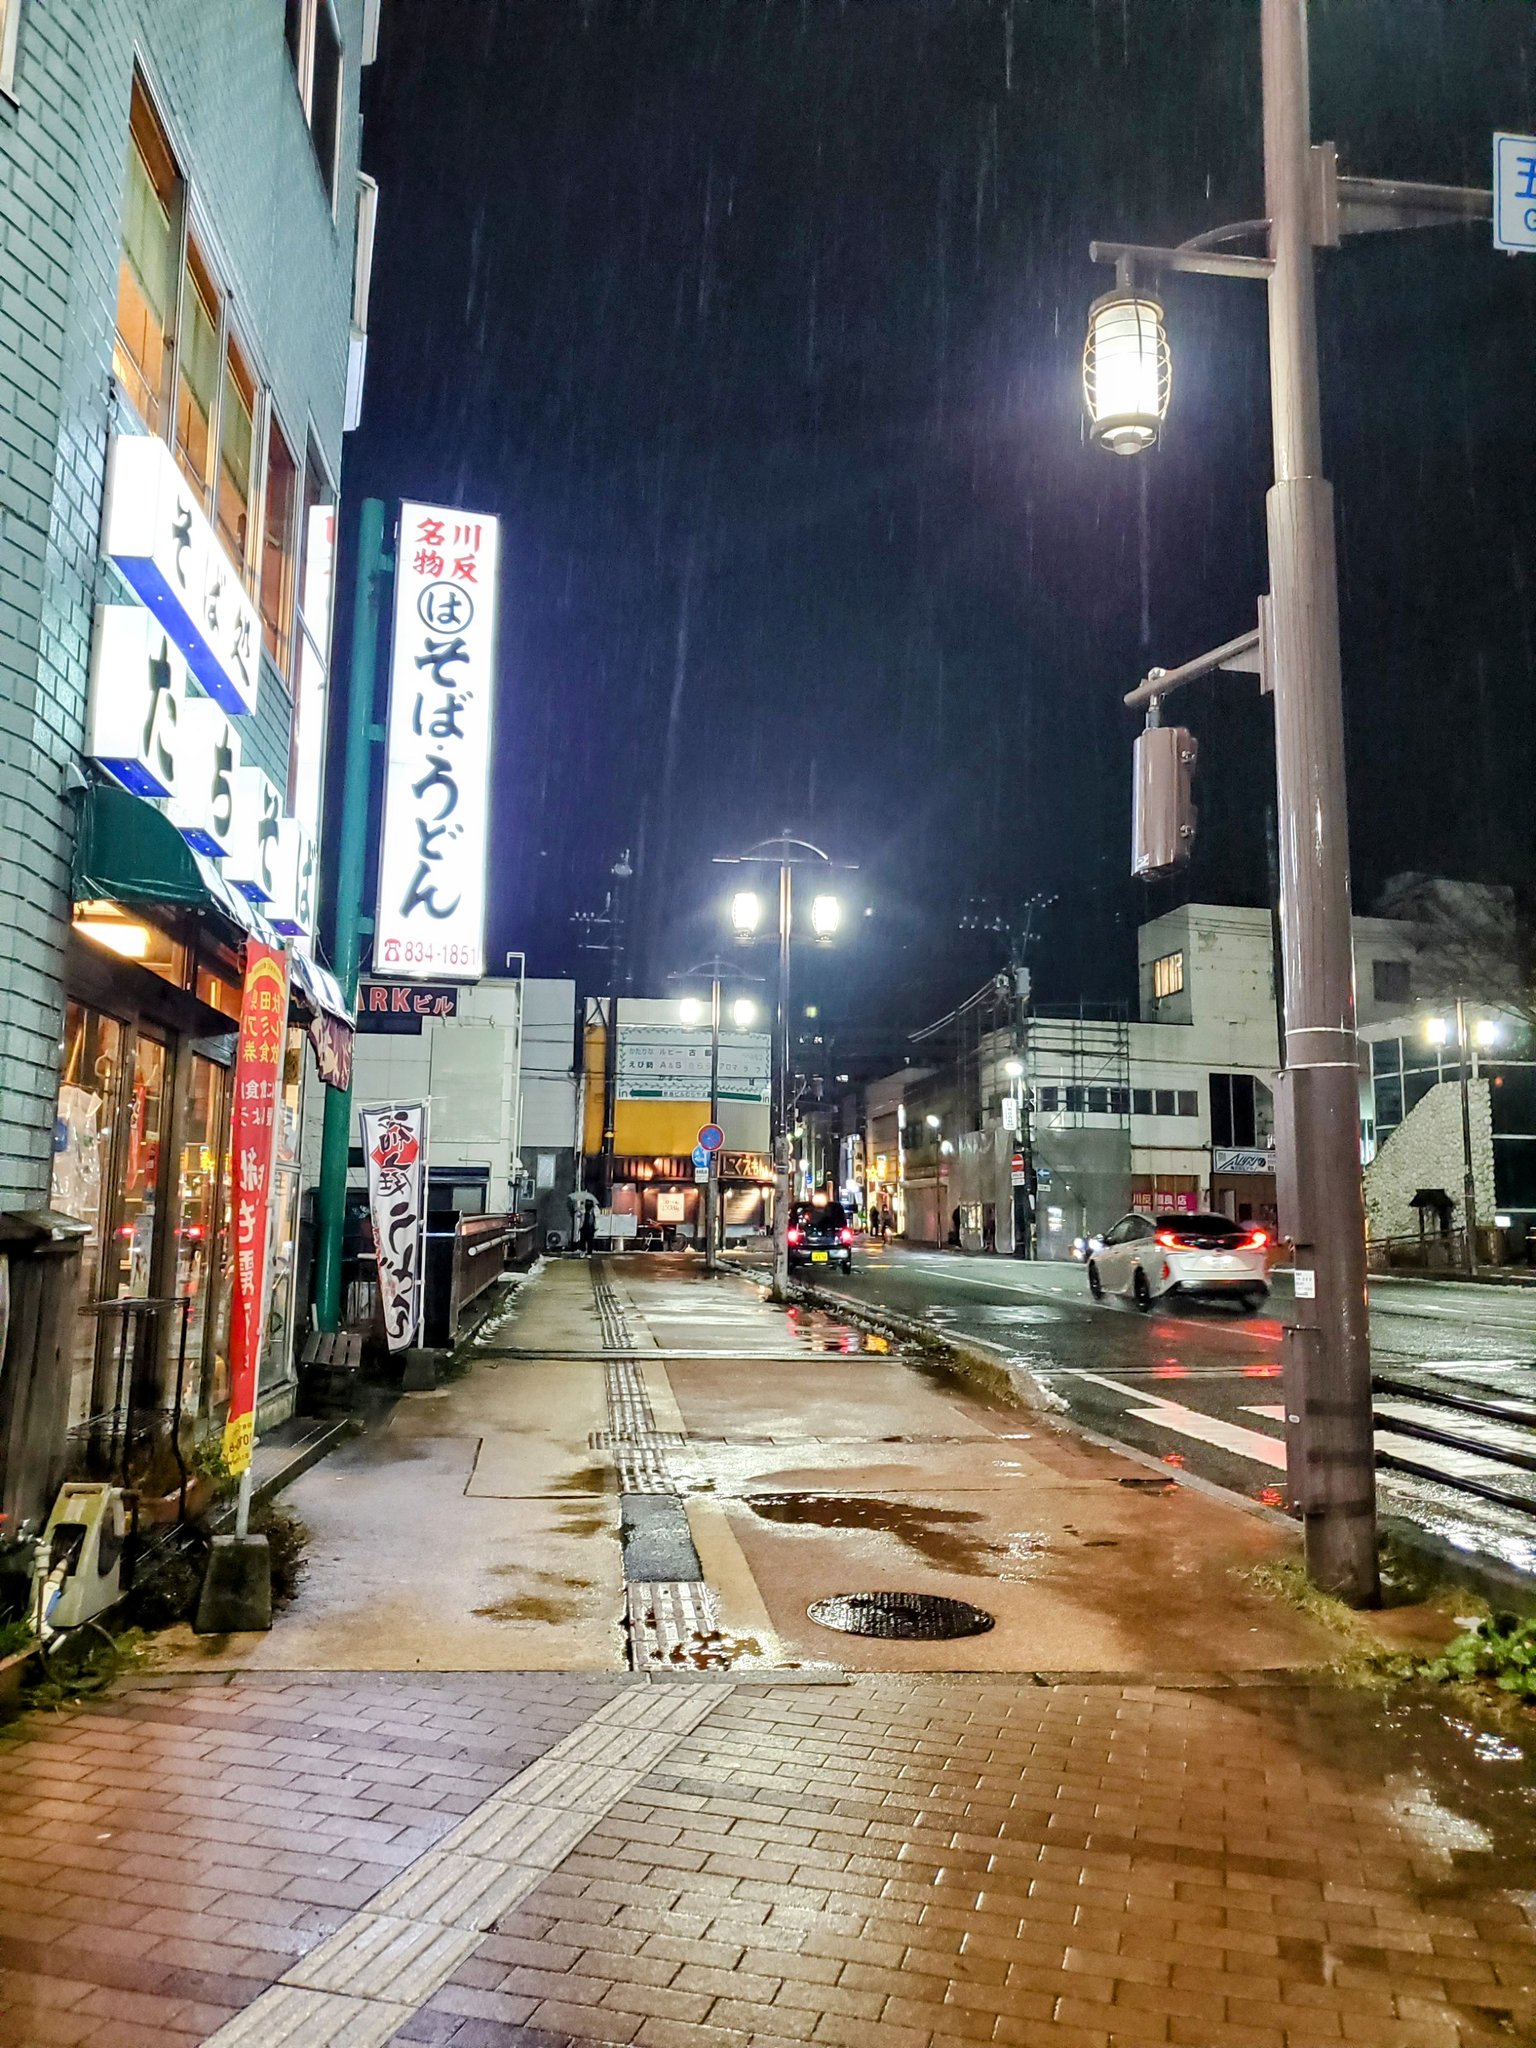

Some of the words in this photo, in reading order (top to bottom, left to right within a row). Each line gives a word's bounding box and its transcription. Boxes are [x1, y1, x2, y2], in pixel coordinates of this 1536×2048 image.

[413, 518, 446, 578] 名物
[452, 525, 482, 583] 川反
[171, 493, 251, 688] そばや
[404, 941, 477, 965] 834-1851
